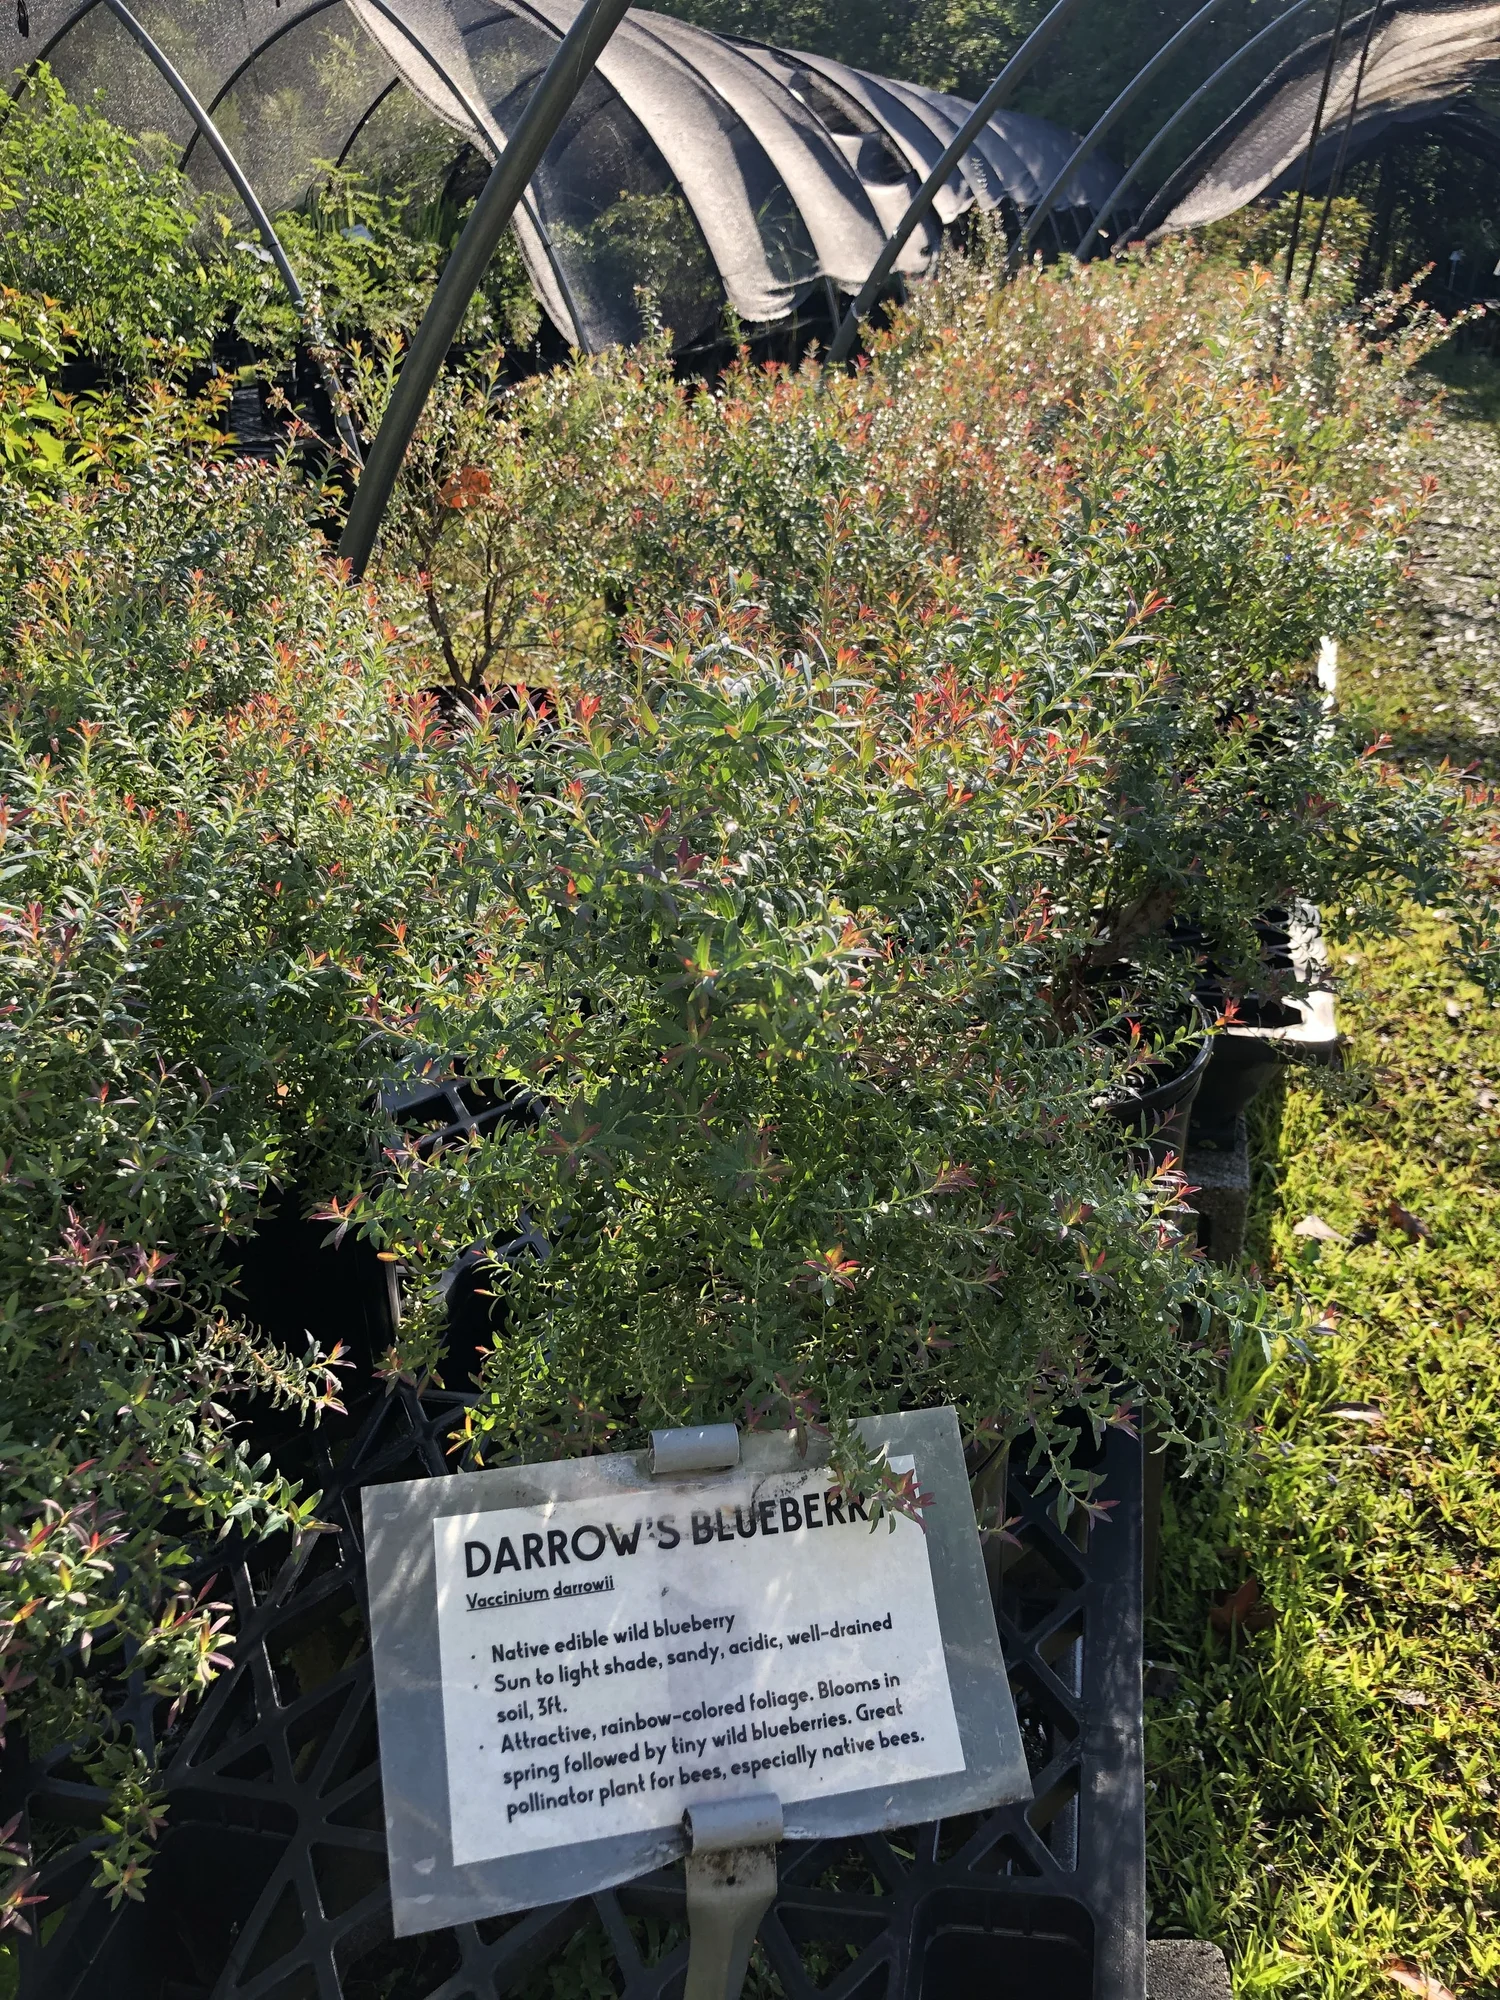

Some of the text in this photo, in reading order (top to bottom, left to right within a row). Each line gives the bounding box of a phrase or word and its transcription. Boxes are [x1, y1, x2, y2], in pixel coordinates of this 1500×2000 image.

[465, 1491, 886, 1578] DARROW'S BLUEBERR
[466, 1574, 614, 1610] Vaccinium darrowii
[491, 1613, 736, 1664] Native edible wild blueberry
[494, 1611, 893, 1693] Sun to light shade, sandy, acidic, well-drained
[496, 1694, 568, 1724] soil, 3ft.
[500, 1672, 901, 1754] Attractive, rainbow-colored foliage. Blooms in
[502, 1697, 904, 1791] spring followed by tiny wild blueberries. Great
[506, 1730, 925, 1824] pollinator plant for bees, especially native bees.
